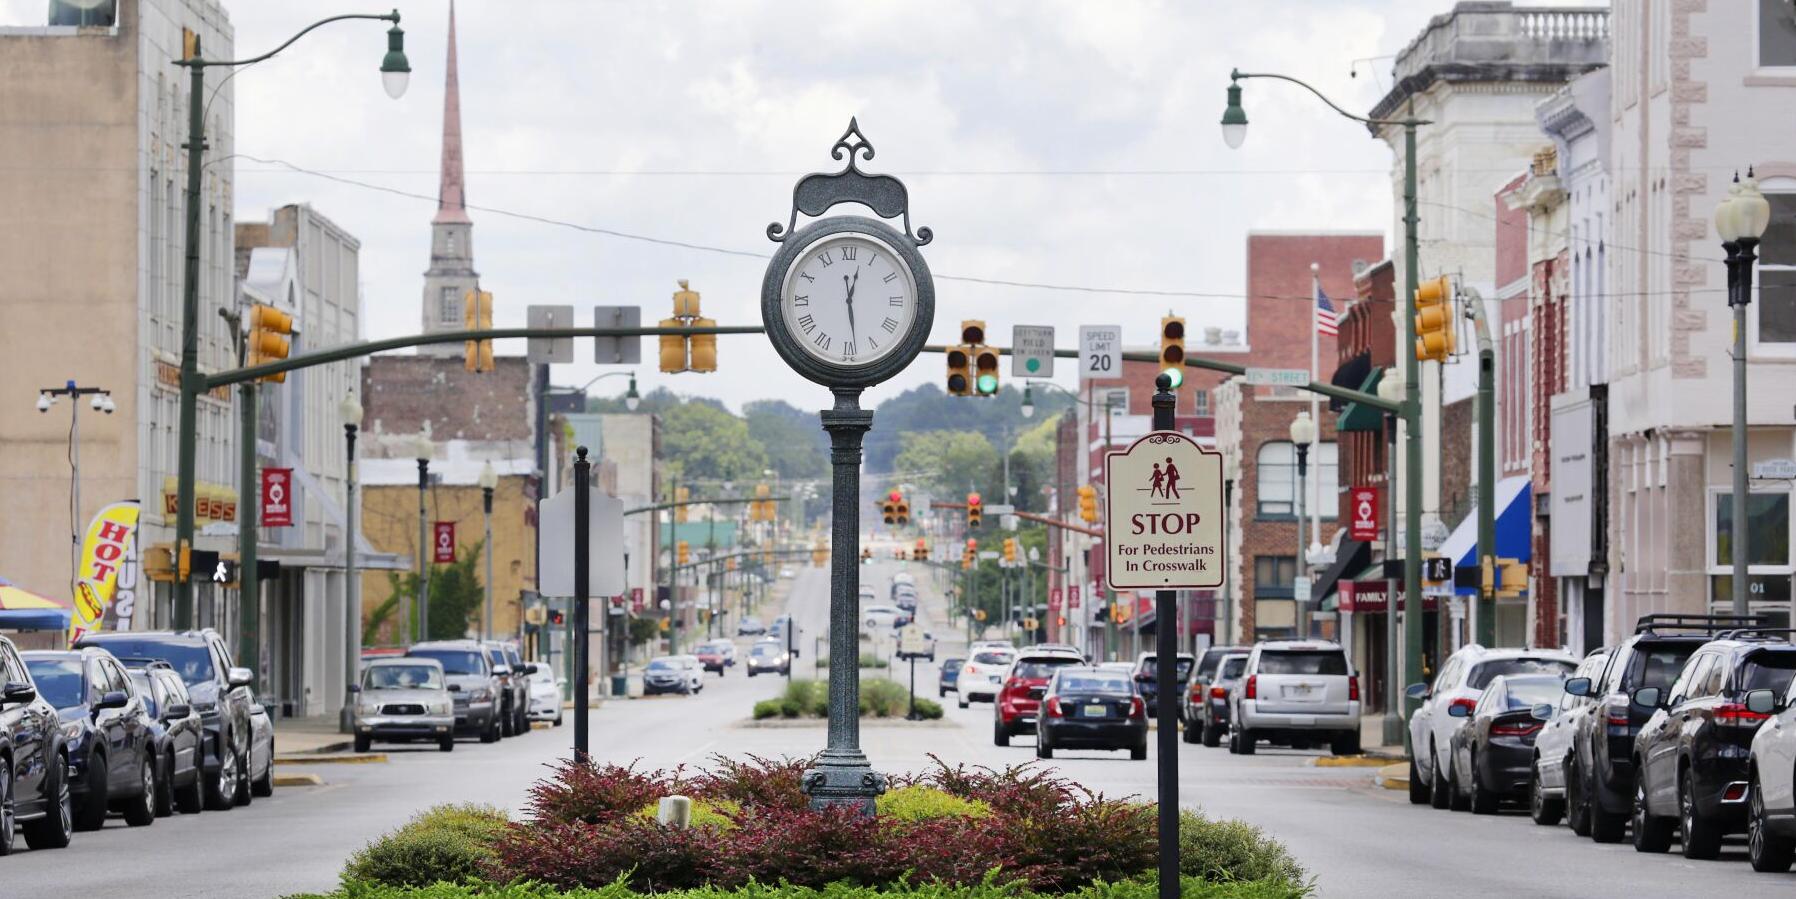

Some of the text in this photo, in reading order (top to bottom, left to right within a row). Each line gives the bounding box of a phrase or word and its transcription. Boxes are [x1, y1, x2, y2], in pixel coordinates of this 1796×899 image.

[818, 251, 833, 268] XI
[841, 247, 857, 261] XII
[868, 253, 877, 266] I
[800, 271, 815, 283] X
[882, 272, 897, 284] II
[795, 295, 808, 307] IX
[889, 296, 903, 307] III
[798, 314, 817, 335] VIII
[814, 332, 832, 351] VII
[868, 336, 879, 350] V
[1023, 338, 1046, 348] YIELD
[1086, 331, 1116, 342] SPEED
[1089, 342, 1112, 352] LIMIT
[1089, 354, 1112, 372] 20
[167, 494, 236, 521] KESS
[1131, 513, 1201, 535] STOP
[93, 520, 130, 582] HOT
[1118, 543, 1214, 556] For Pedestrians
[1126, 559, 1207, 572] In Crosswalk
[1356, 591, 1388, 602] FAMILY
